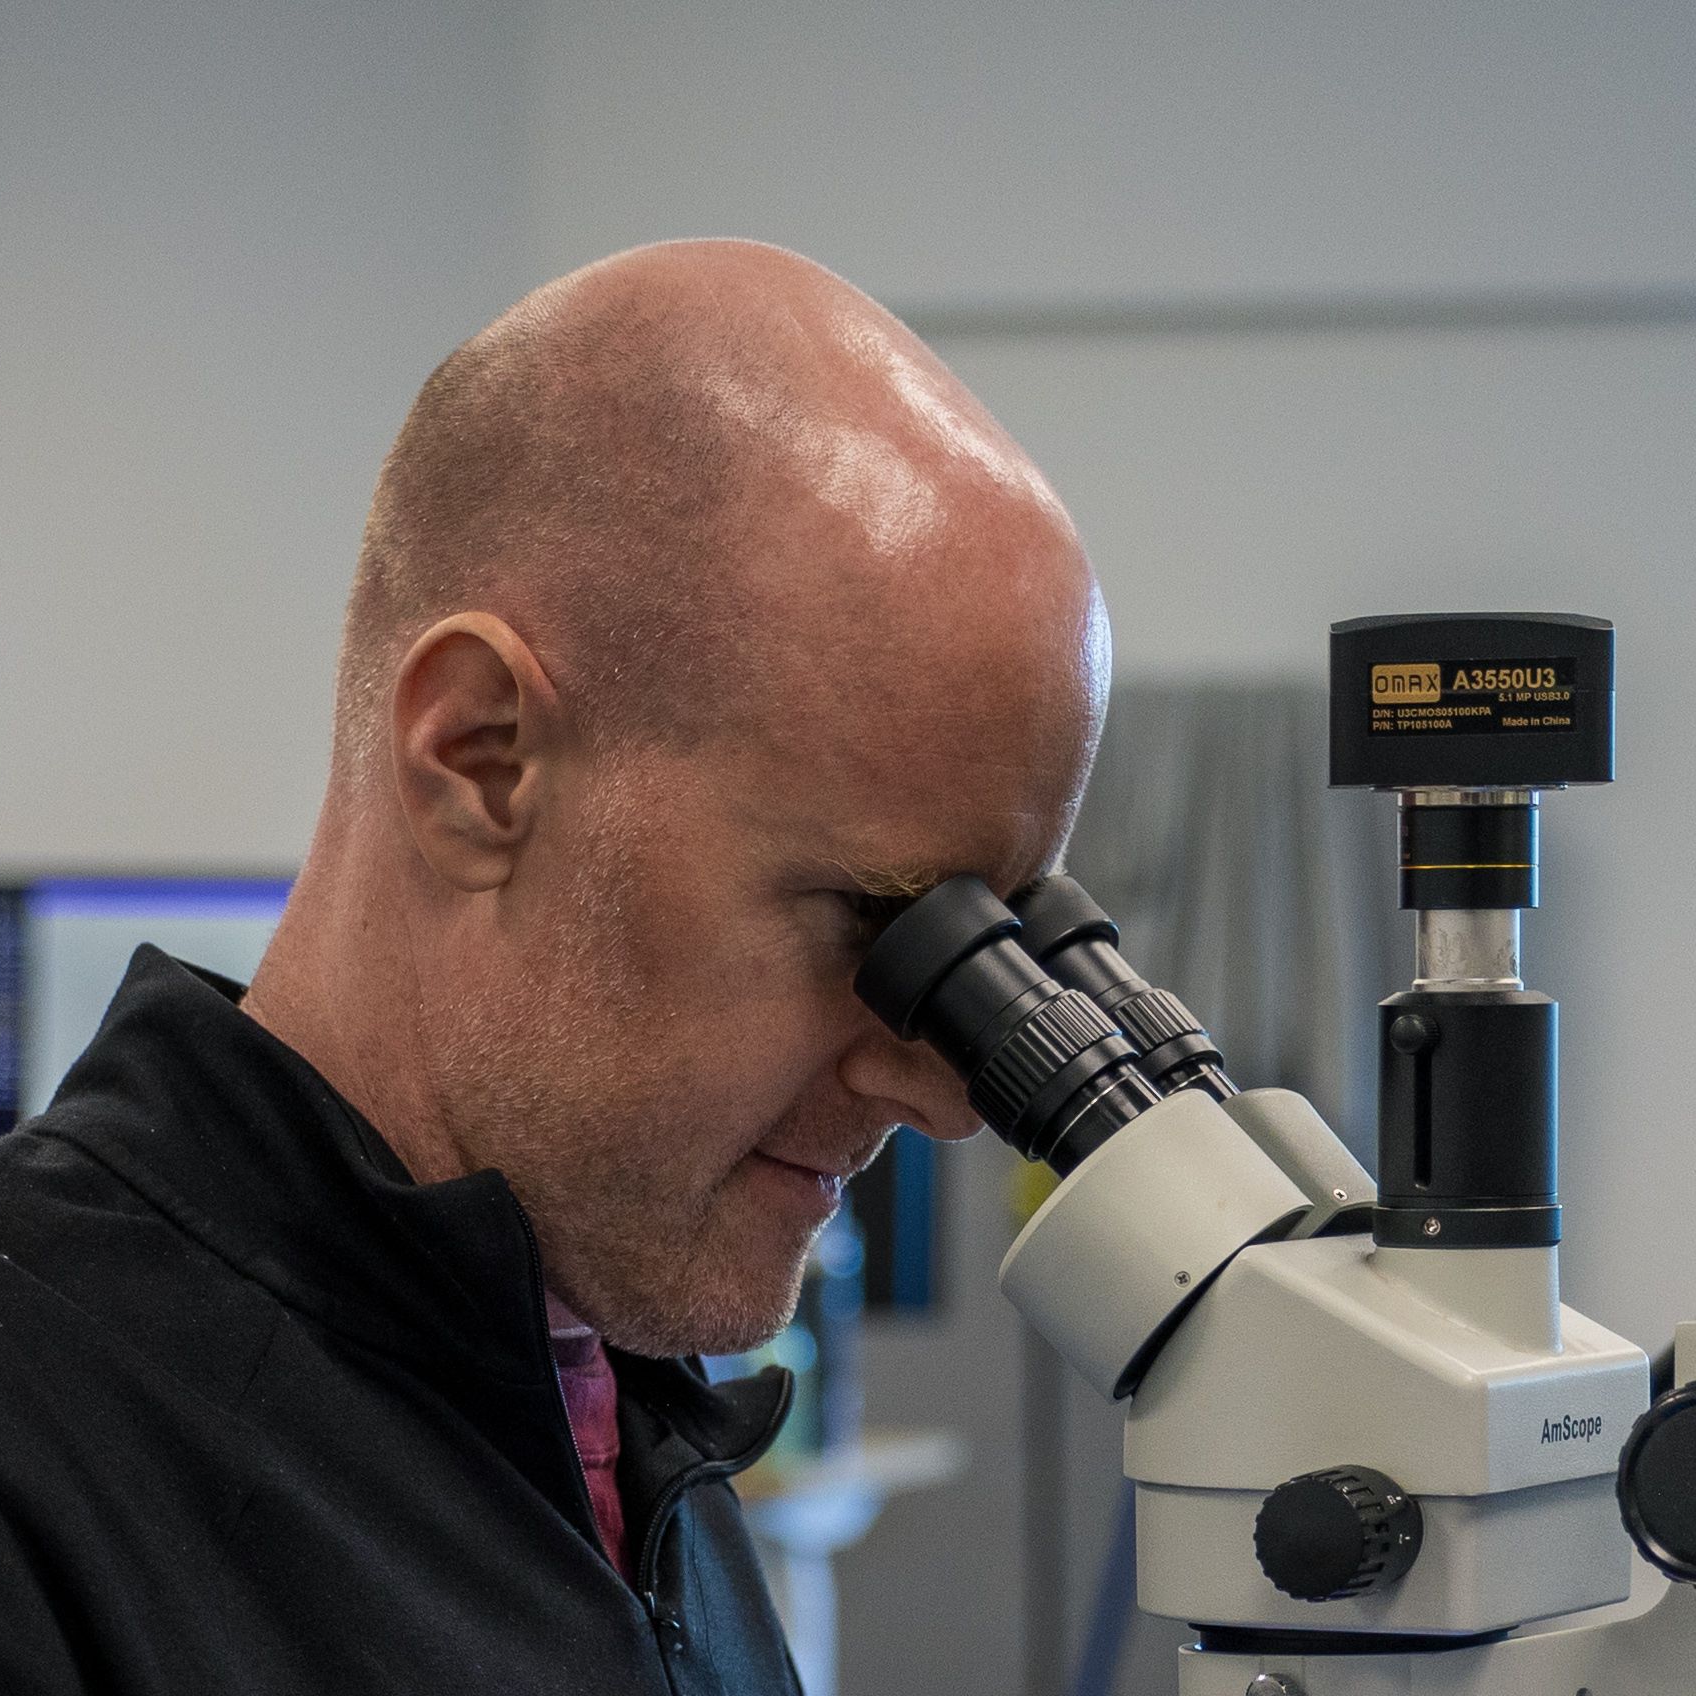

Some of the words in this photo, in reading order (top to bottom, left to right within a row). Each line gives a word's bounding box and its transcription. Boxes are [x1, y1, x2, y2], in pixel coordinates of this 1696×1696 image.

[1374, 673, 1439, 694] OMAX
[1452, 667, 1556, 691] A3550U3
[1498, 692, 1513, 702] 5.1
[1516, 692, 1532, 702] MP
[1534, 691, 1570, 701] USB3.0
[1372, 708, 1394, 718] D/N:
[1372, 720, 1394, 731] P/N:
[1396, 719, 1453, 730] TP105100A
[1502, 716, 1529, 726] Made
[1530, 716, 1540, 726] in
[1542, 716, 1571, 726] China
[1540, 1414, 1602, 1444] AmScope
